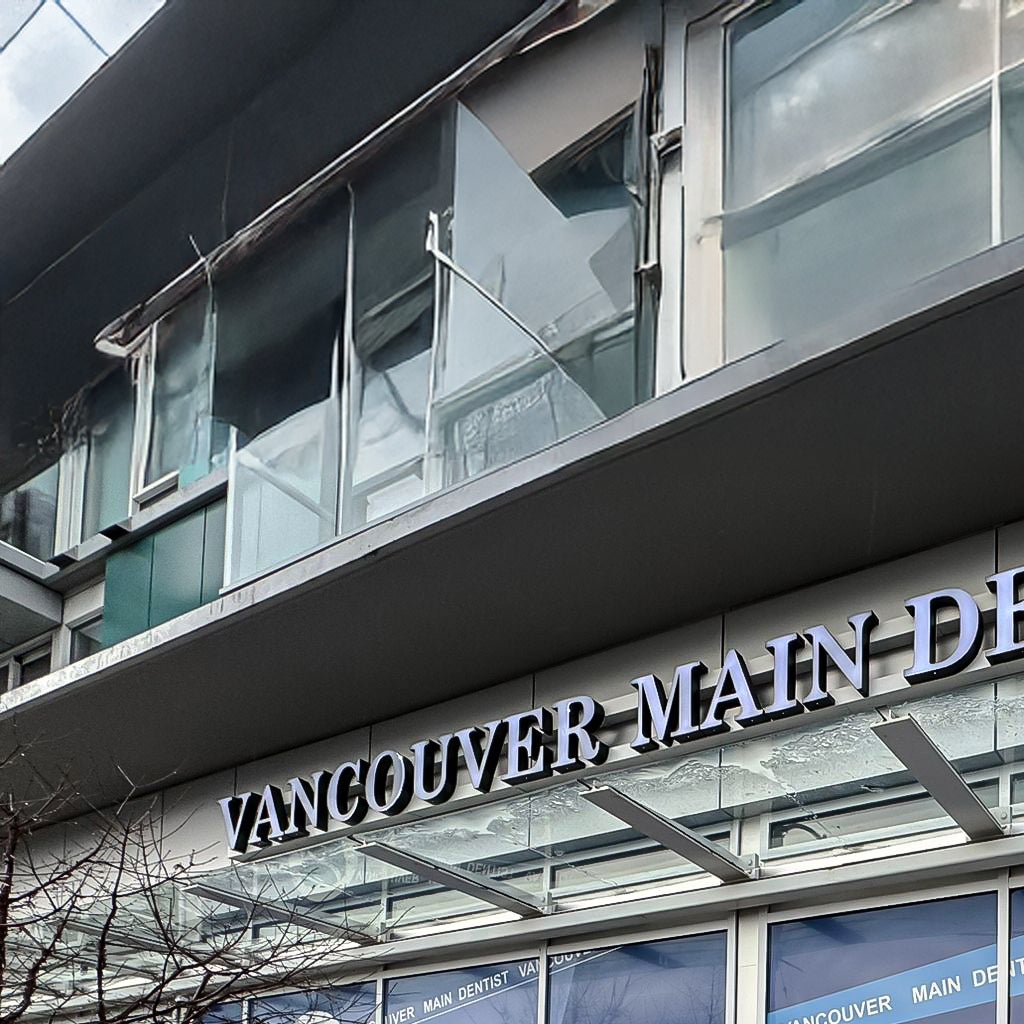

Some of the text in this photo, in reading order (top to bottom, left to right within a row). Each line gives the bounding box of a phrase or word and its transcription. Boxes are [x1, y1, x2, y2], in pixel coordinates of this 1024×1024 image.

[218, 695, 607, 854] VANCOUVER
[630, 610, 879, 753] MAIN
[423, 992, 453, 1014] MAIN
[458, 970, 509, 1001] DENTIST
[911, 975, 962, 1004] MAIN
